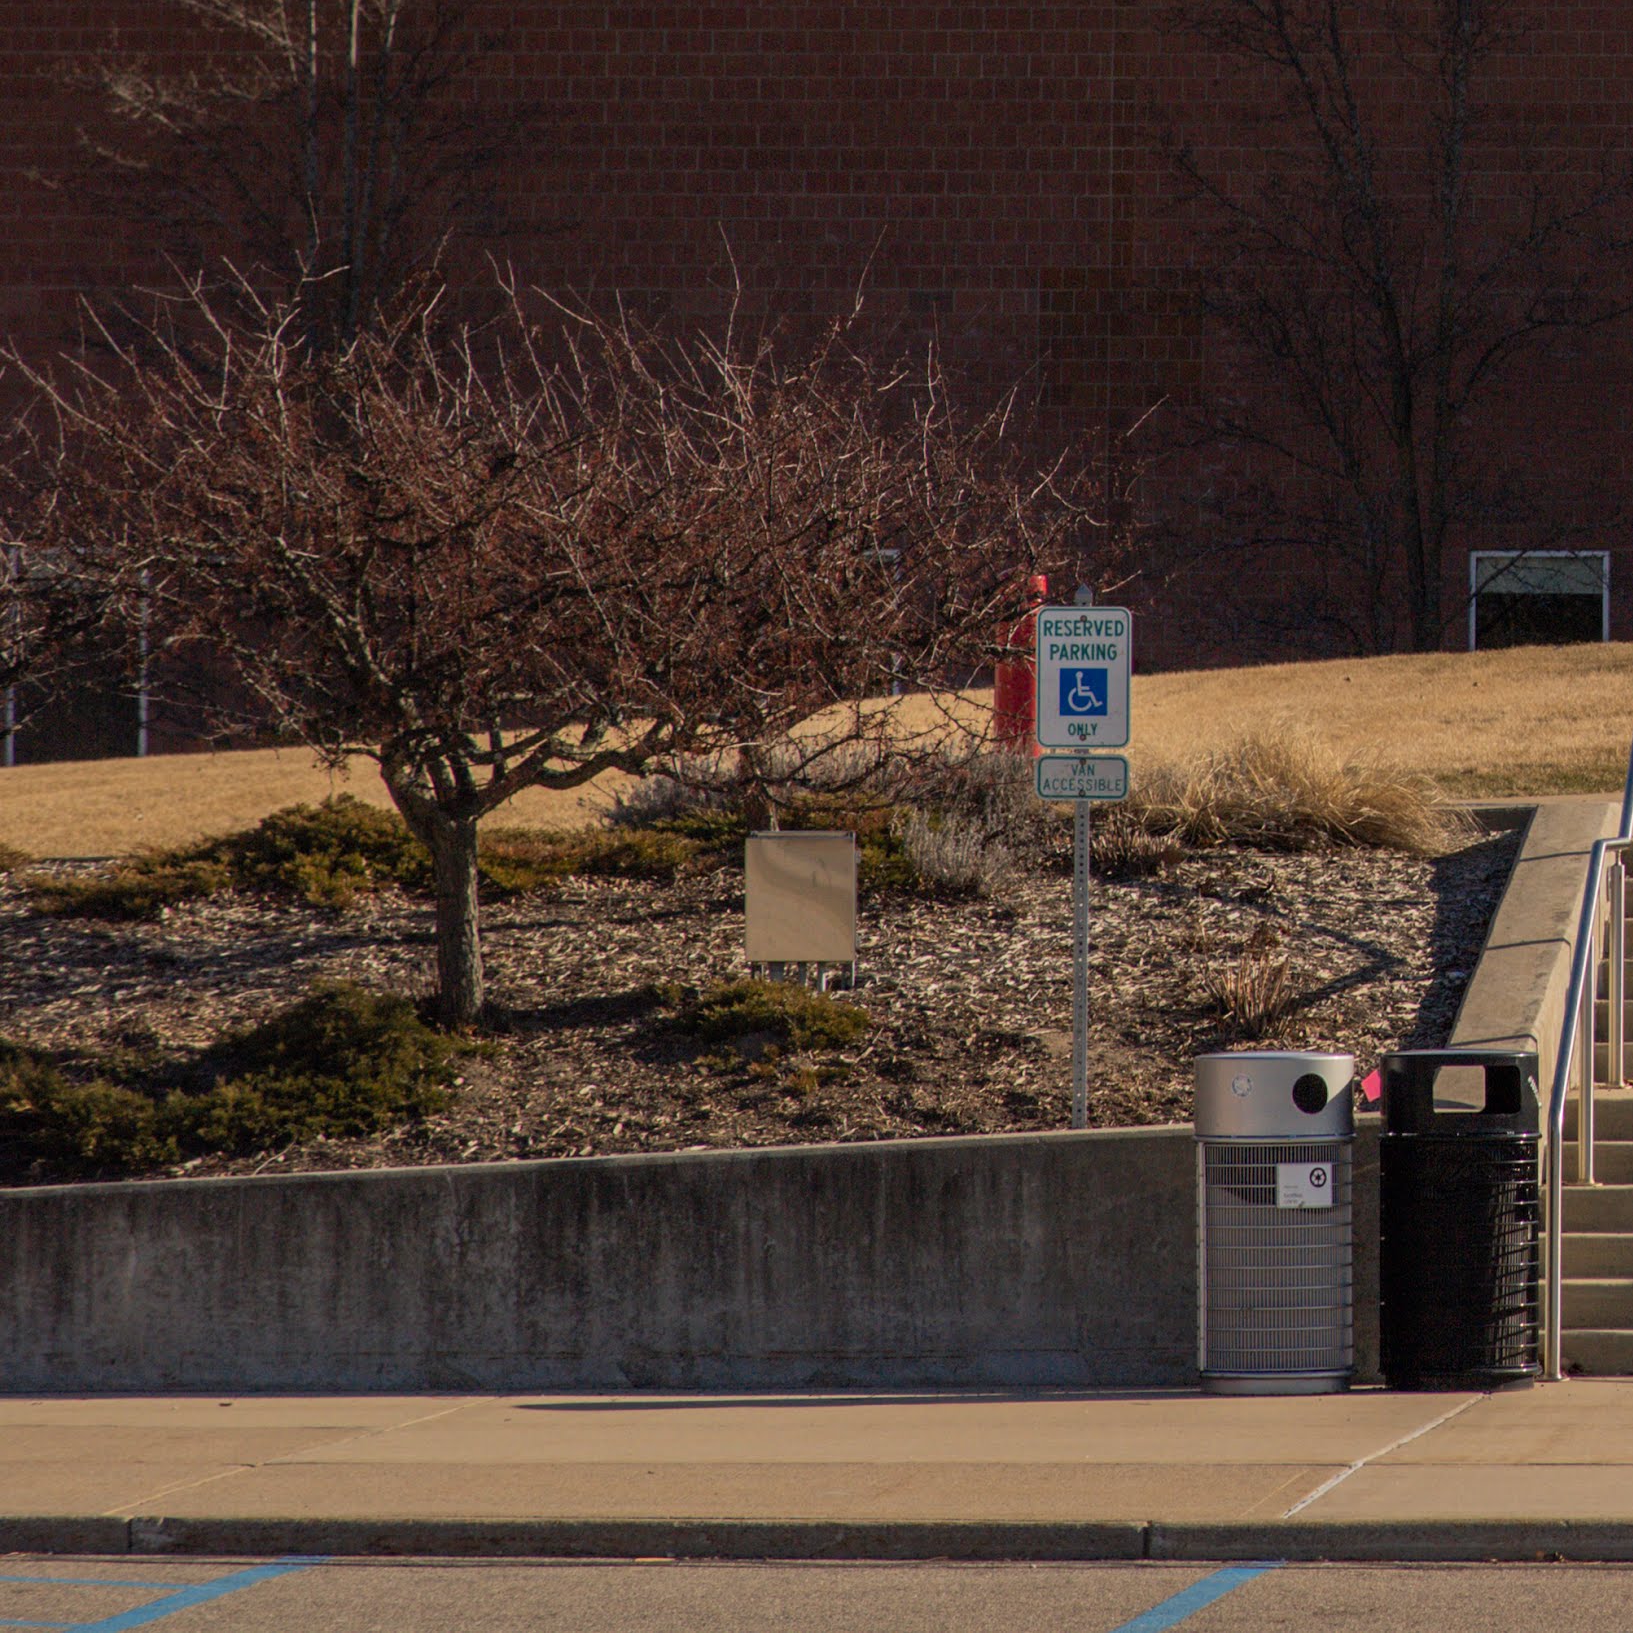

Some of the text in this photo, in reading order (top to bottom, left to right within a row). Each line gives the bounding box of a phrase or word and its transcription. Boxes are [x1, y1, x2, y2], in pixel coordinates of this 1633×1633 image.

[1043, 620, 1125, 637] RESERVED
[1049, 644, 1117, 661] PARKING
[1067, 723, 1098, 736] ONLY
[1071, 764, 1095, 777] VAN
[1043, 778, 1122, 792] ACCESSIBLE
